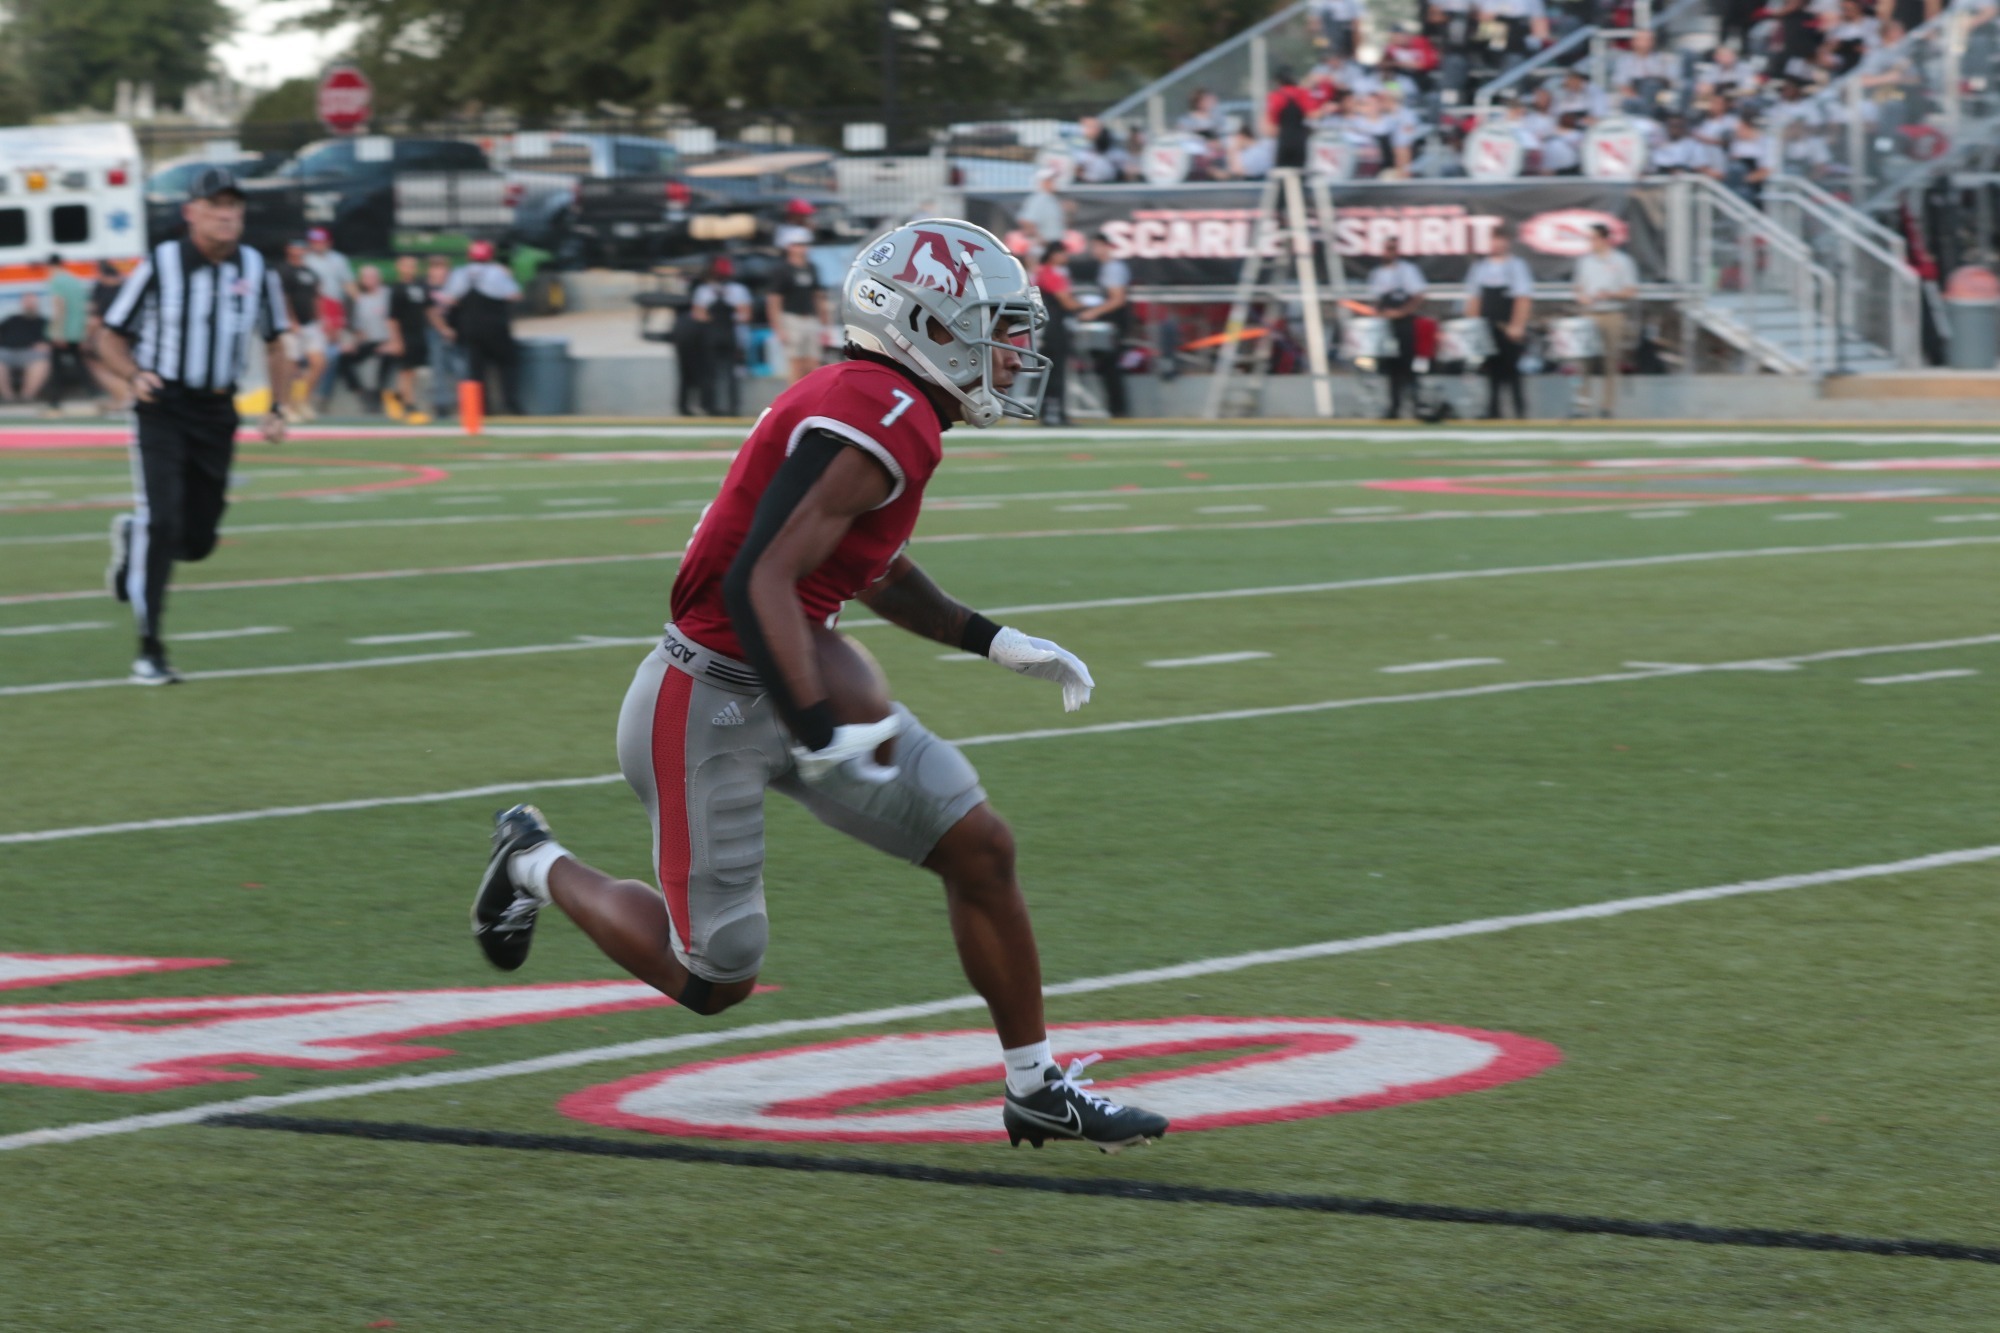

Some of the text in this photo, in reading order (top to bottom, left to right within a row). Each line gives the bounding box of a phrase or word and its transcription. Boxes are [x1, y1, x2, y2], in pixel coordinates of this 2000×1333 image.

[1099, 218, 1319, 259] SCARLE
[1333, 214, 1504, 257] SPIRIT
[892, 230, 985, 298] N
[858, 284, 887, 307] SAC
[880, 387, 915, 428] 7
[711, 715, 745, 726] adidas
